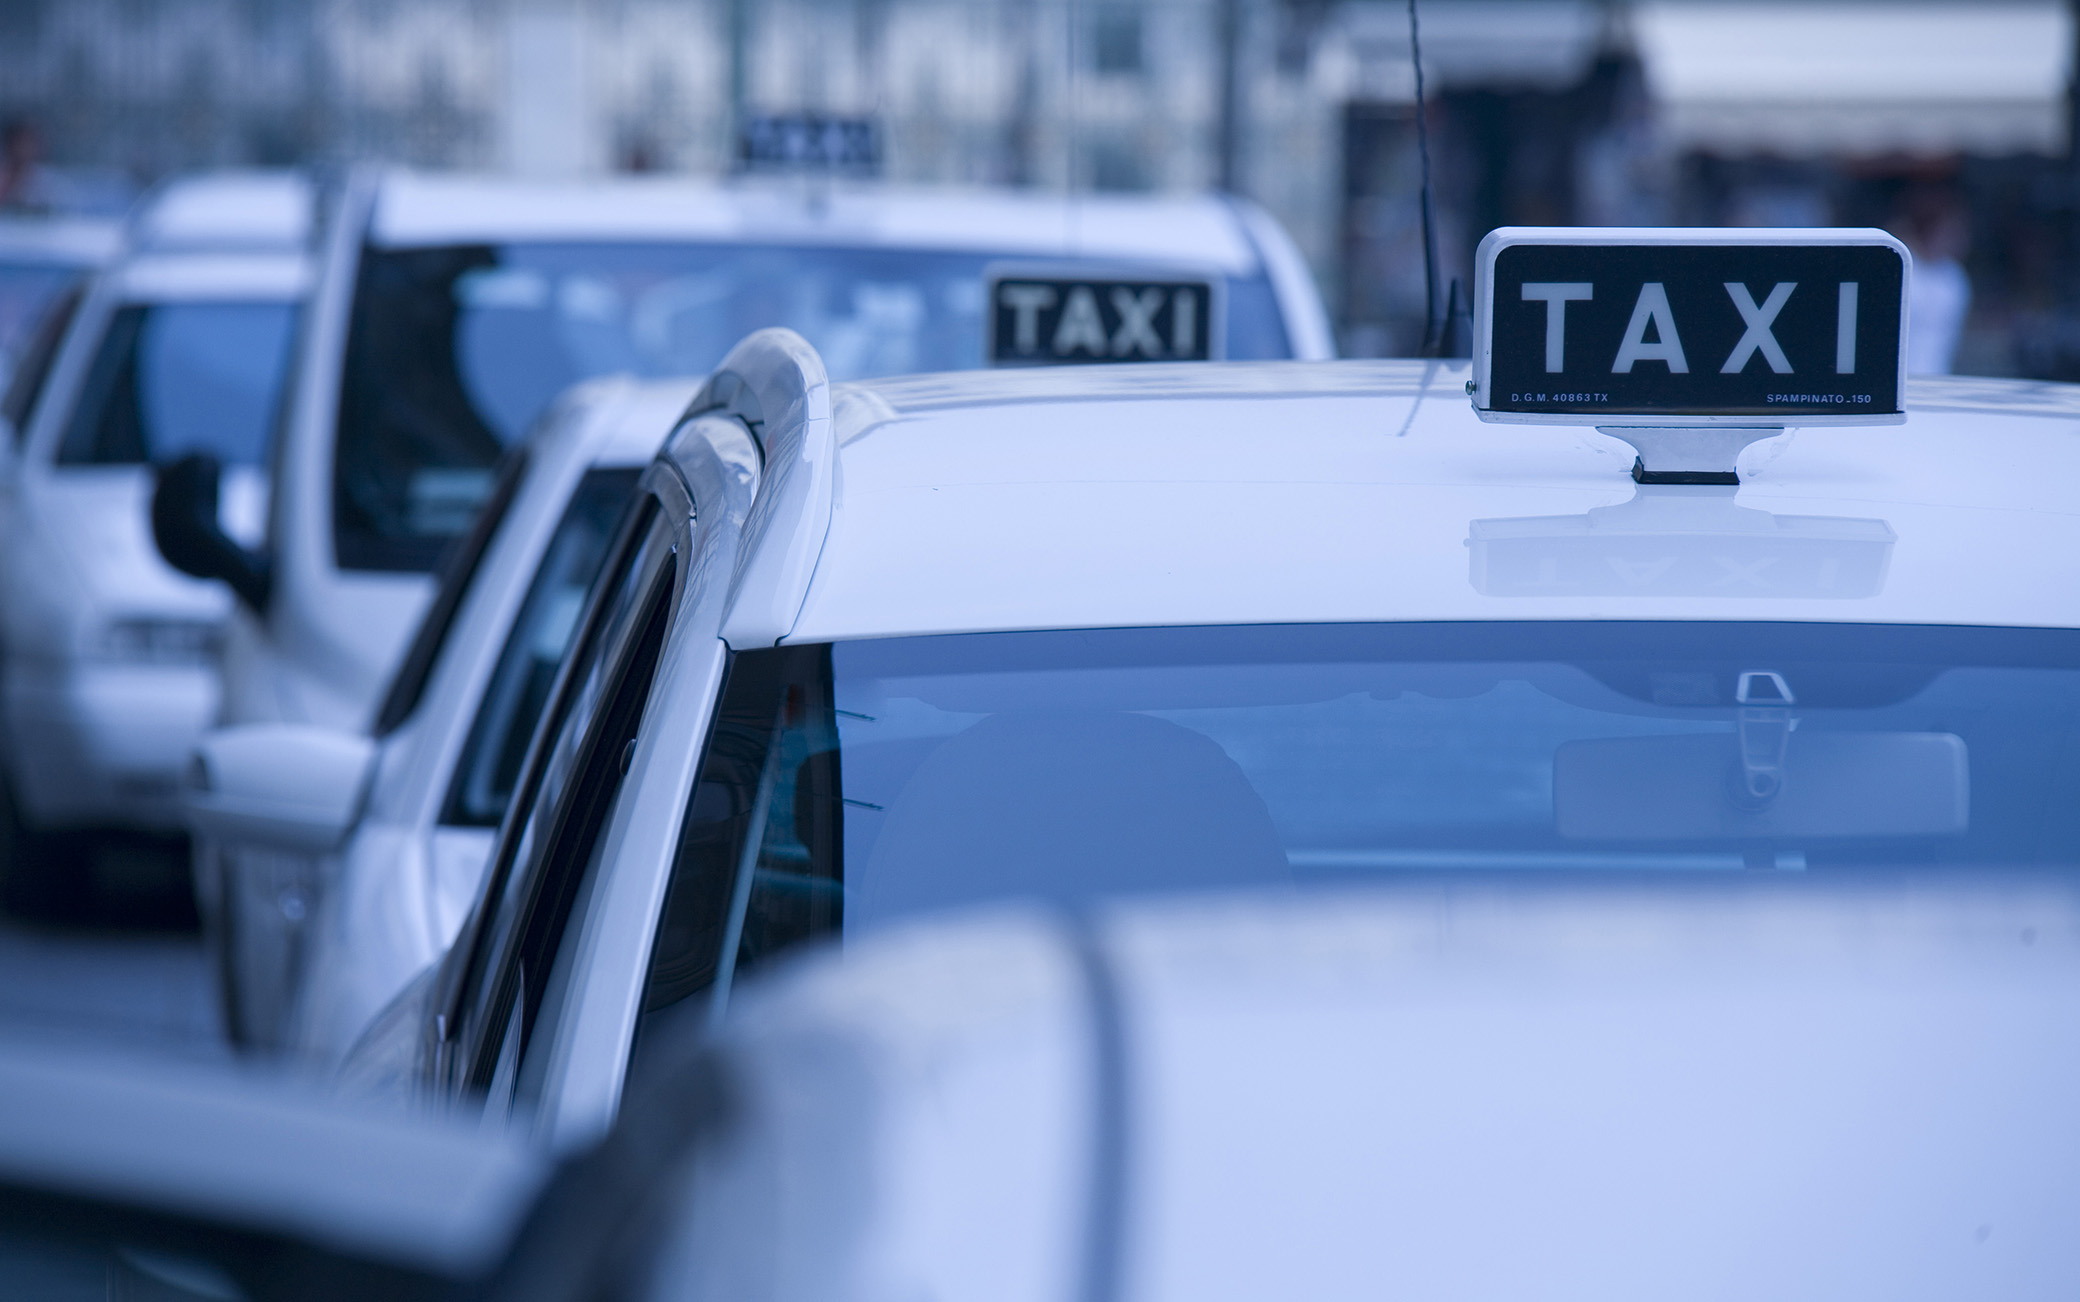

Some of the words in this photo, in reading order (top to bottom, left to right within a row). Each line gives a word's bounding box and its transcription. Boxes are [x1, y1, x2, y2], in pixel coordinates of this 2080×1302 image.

[1001, 285, 1197, 355] TAXI
[1521, 282, 1859, 374] TAXI
[1511, 393, 1549, 402] D.G.M.
[1552, 393, 1591, 402] 40863
